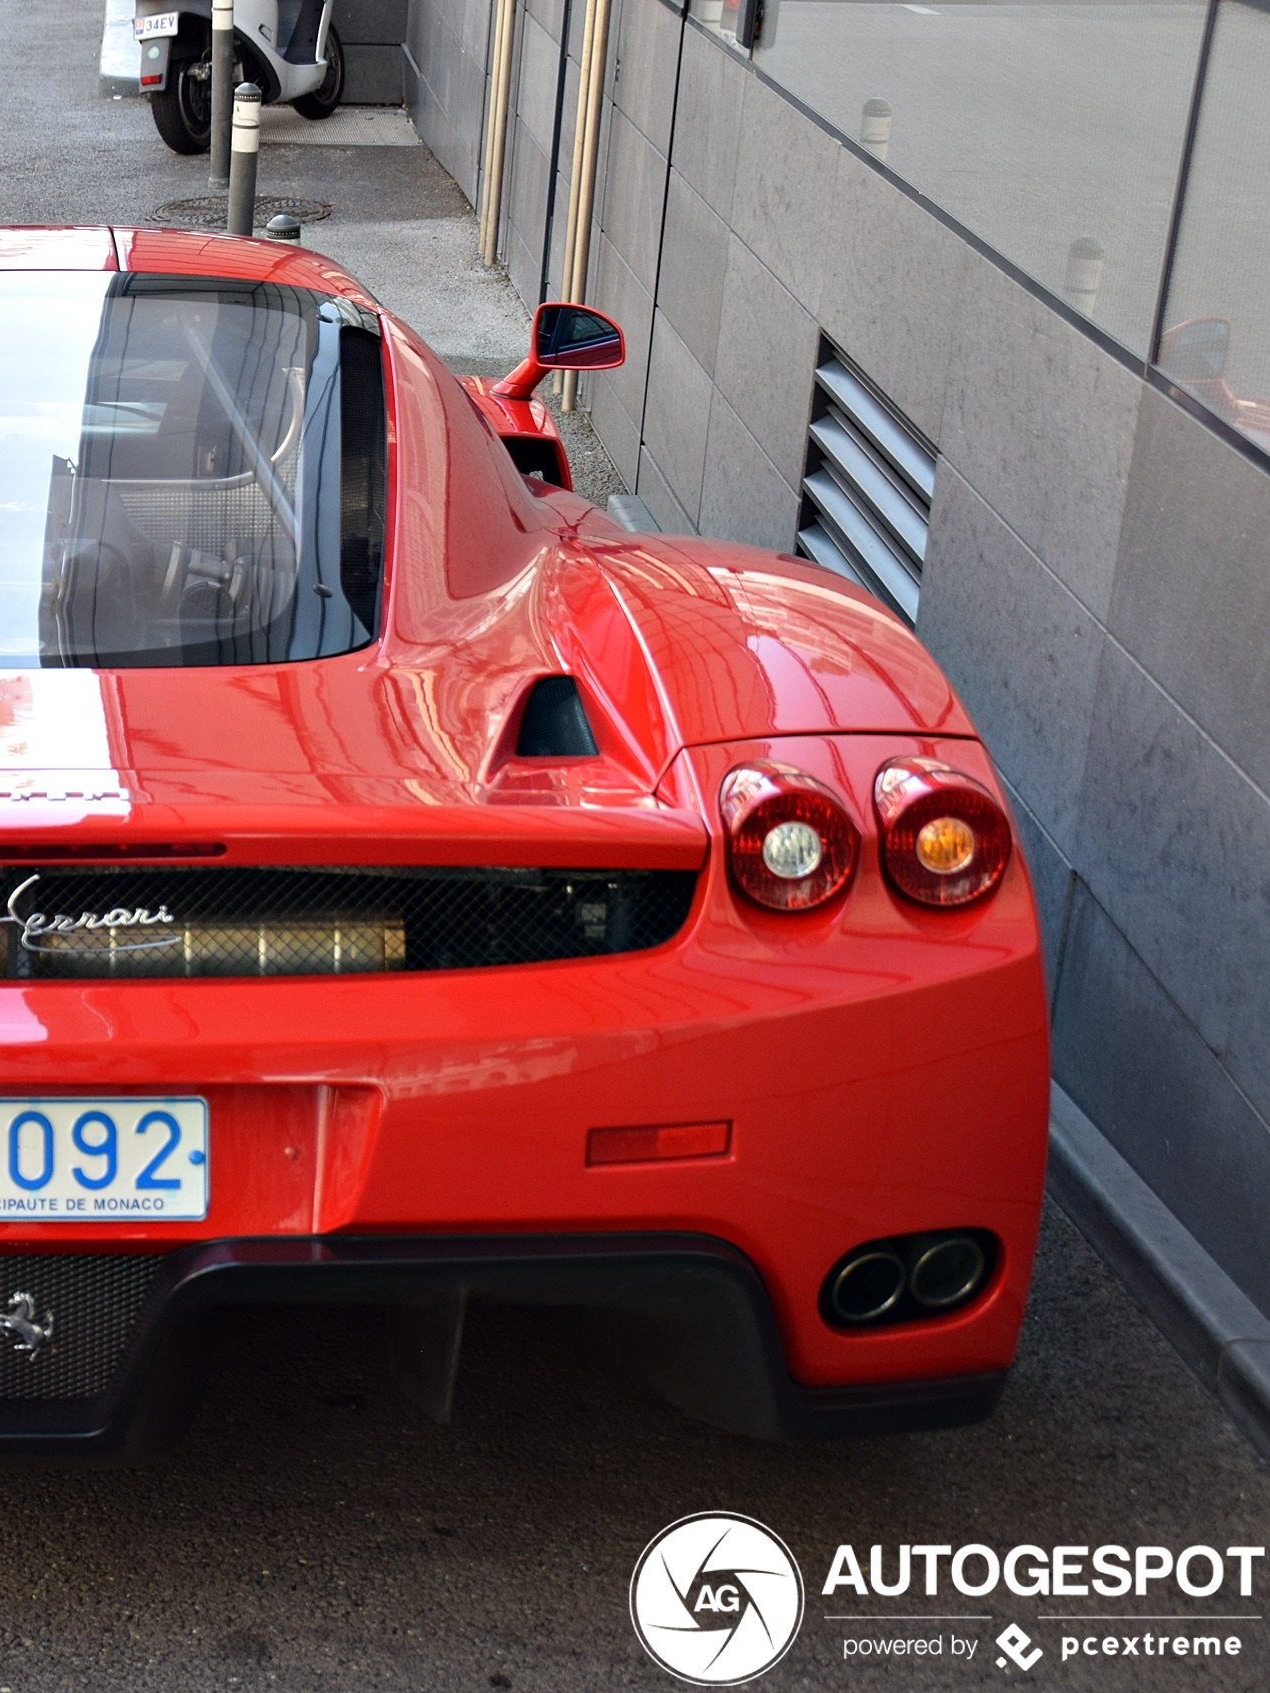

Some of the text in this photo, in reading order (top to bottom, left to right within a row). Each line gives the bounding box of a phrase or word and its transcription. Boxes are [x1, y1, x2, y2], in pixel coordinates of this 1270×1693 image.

[7, 874, 181, 952] Ferrari
[65, 1198, 86, 1211] DE
[93, 1198, 165, 1211] MONACO
